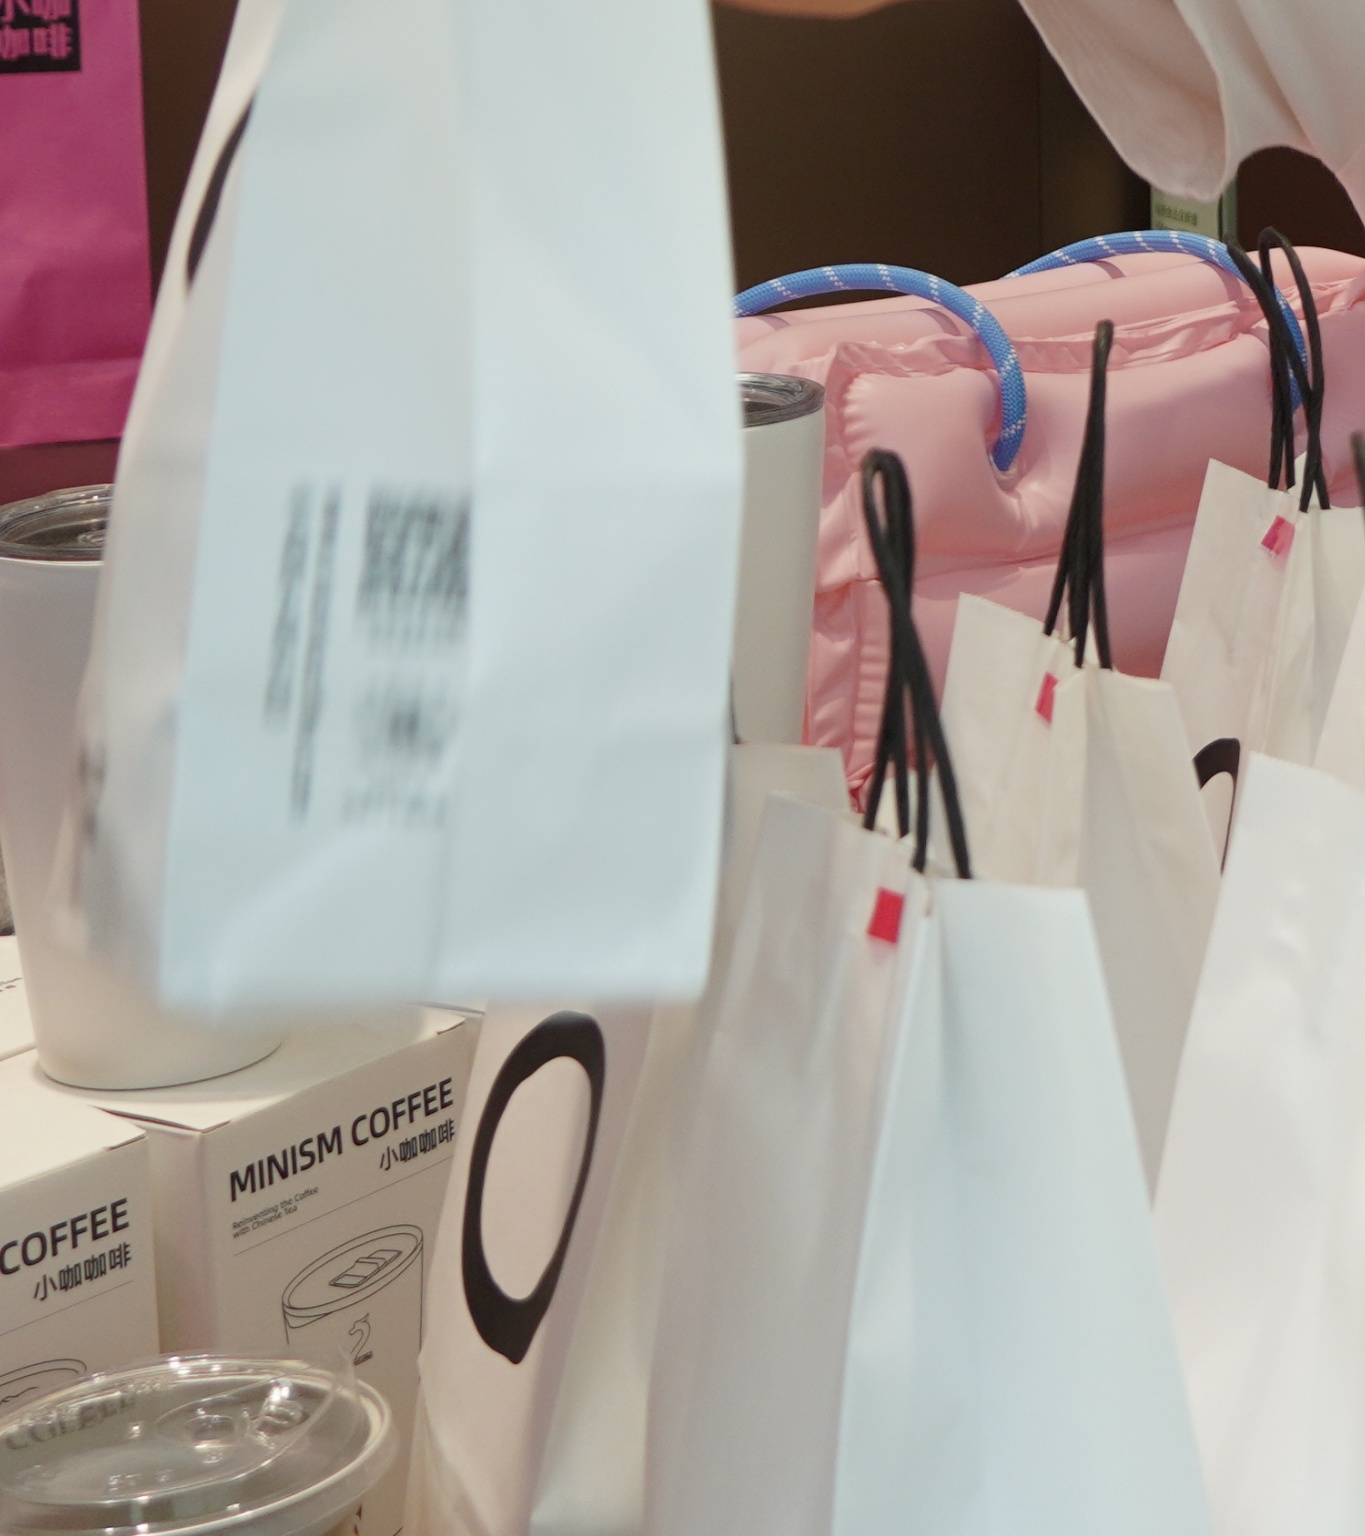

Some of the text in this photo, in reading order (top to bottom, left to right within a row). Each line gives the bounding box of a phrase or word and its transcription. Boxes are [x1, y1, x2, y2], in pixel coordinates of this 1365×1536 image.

[228, 1077, 455, 1202] MINISM COFFEE
[378, 1118, 457, 1172] 小咖咖啡
[0, 1197, 130, 1278] COFFEE
[33, 1240, 132, 1302] 小咖咖啡
